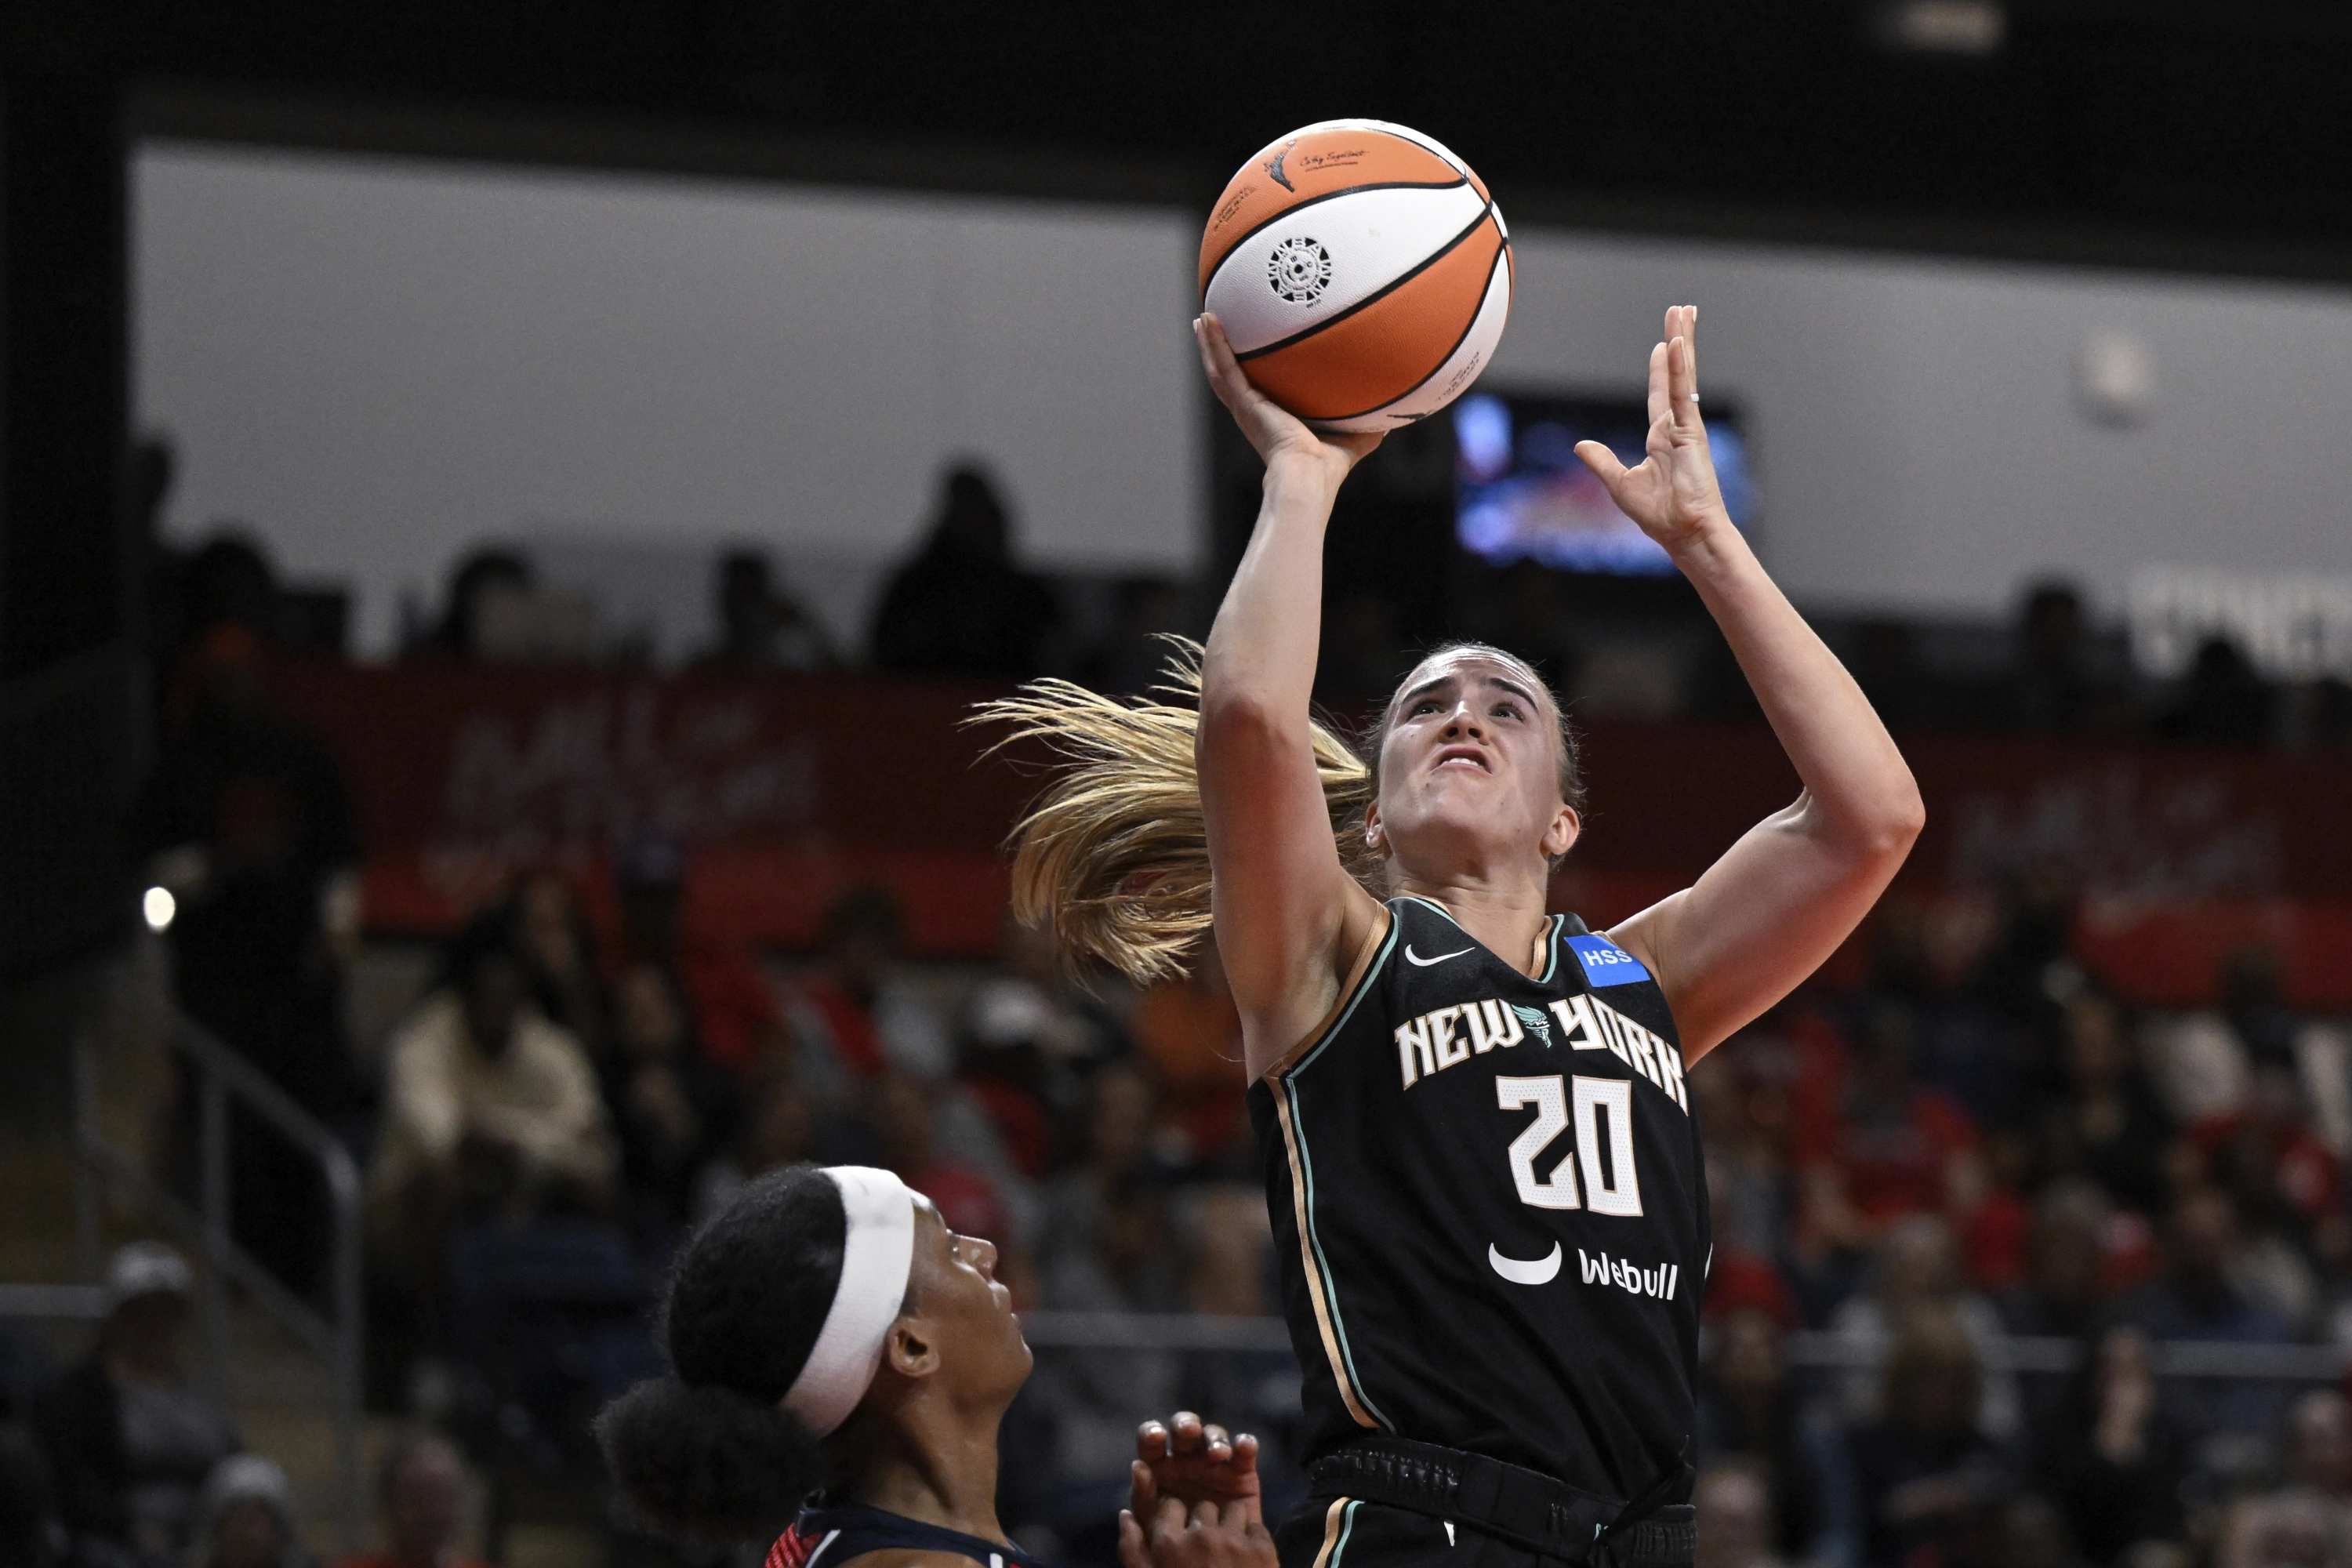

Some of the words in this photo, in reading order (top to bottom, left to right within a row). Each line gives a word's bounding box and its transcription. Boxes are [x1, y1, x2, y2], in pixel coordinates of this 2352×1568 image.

[1583, 949, 1633, 967] HSS
[1394, 997, 1525, 1091] NEW
[1548, 993, 1689, 1117] YORK
[1495, 1074, 1644, 1218] 20
[1577, 1248, 1678, 1301] Webull
